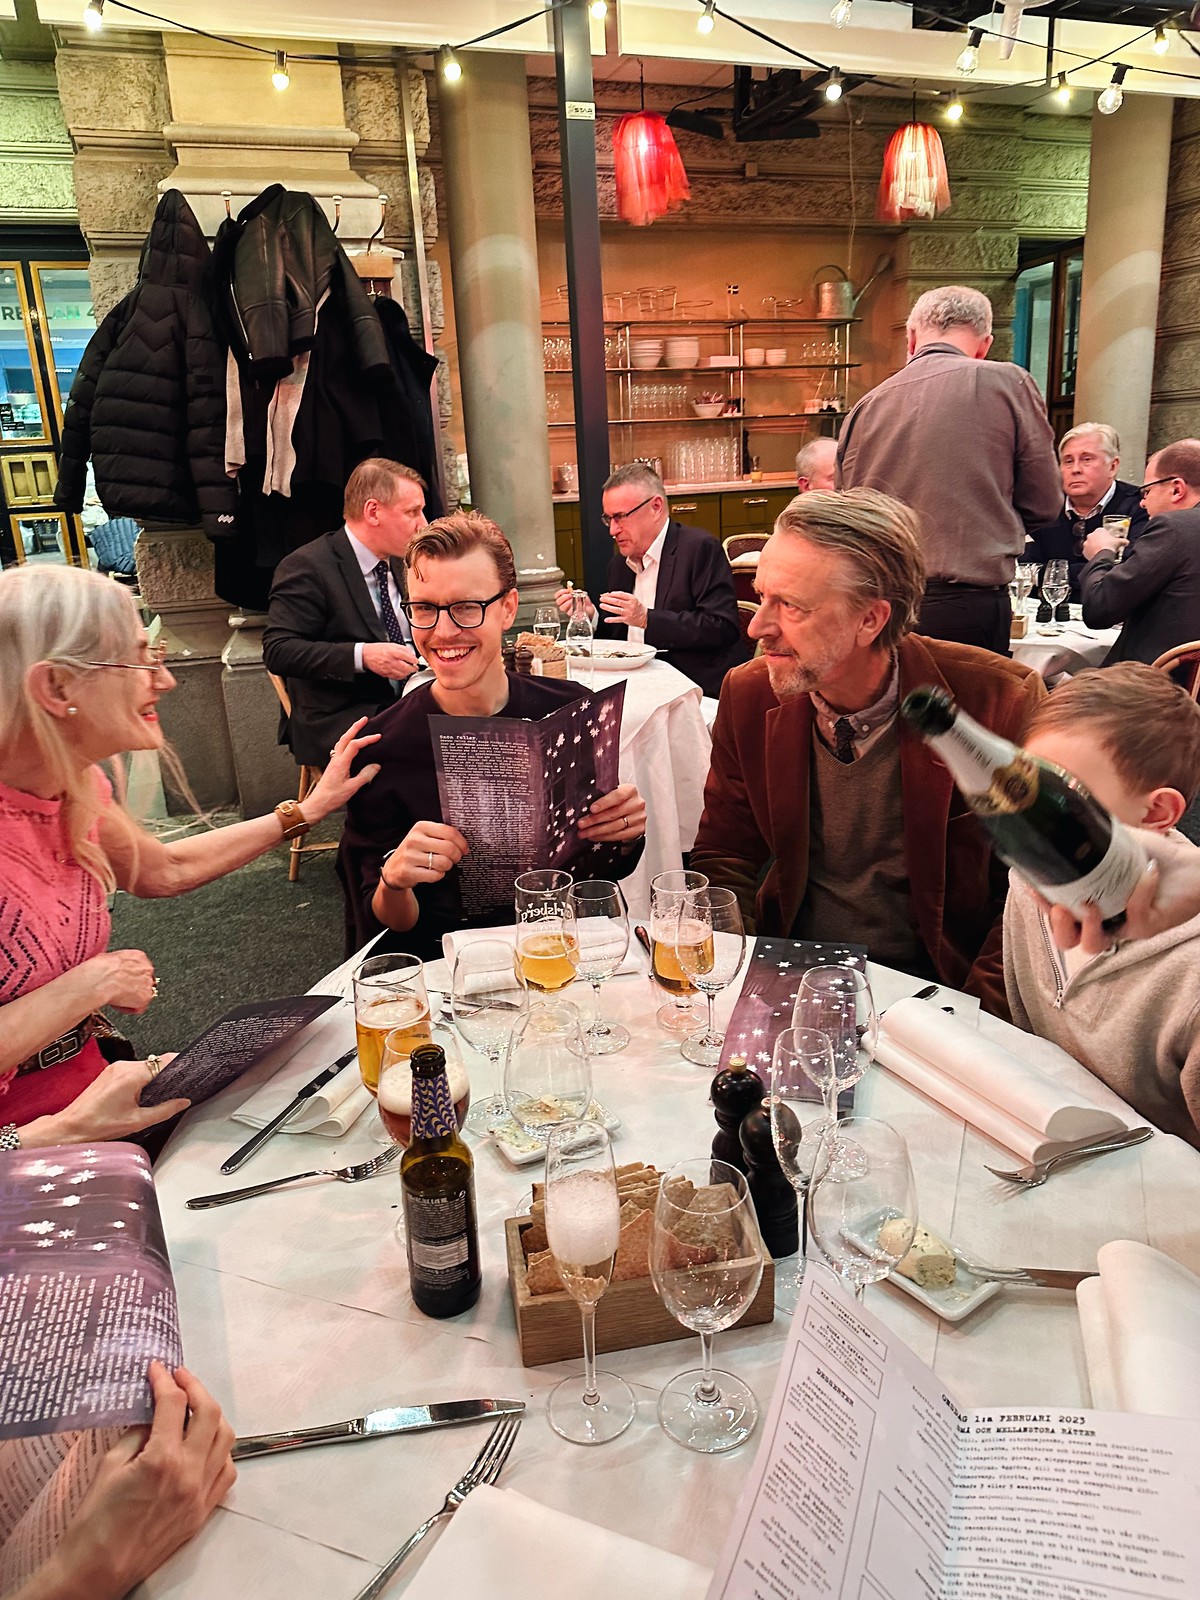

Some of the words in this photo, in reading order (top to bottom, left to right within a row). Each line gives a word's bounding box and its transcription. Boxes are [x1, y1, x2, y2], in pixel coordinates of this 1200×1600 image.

[1000, 1414, 1052, 1423] FEBRUARI
[1058, 1415, 1087, 1425] 2023
[996, 1427, 1056, 1435] MELLANSTORA
[1061, 1427, 1097, 1438] RÄTTER
